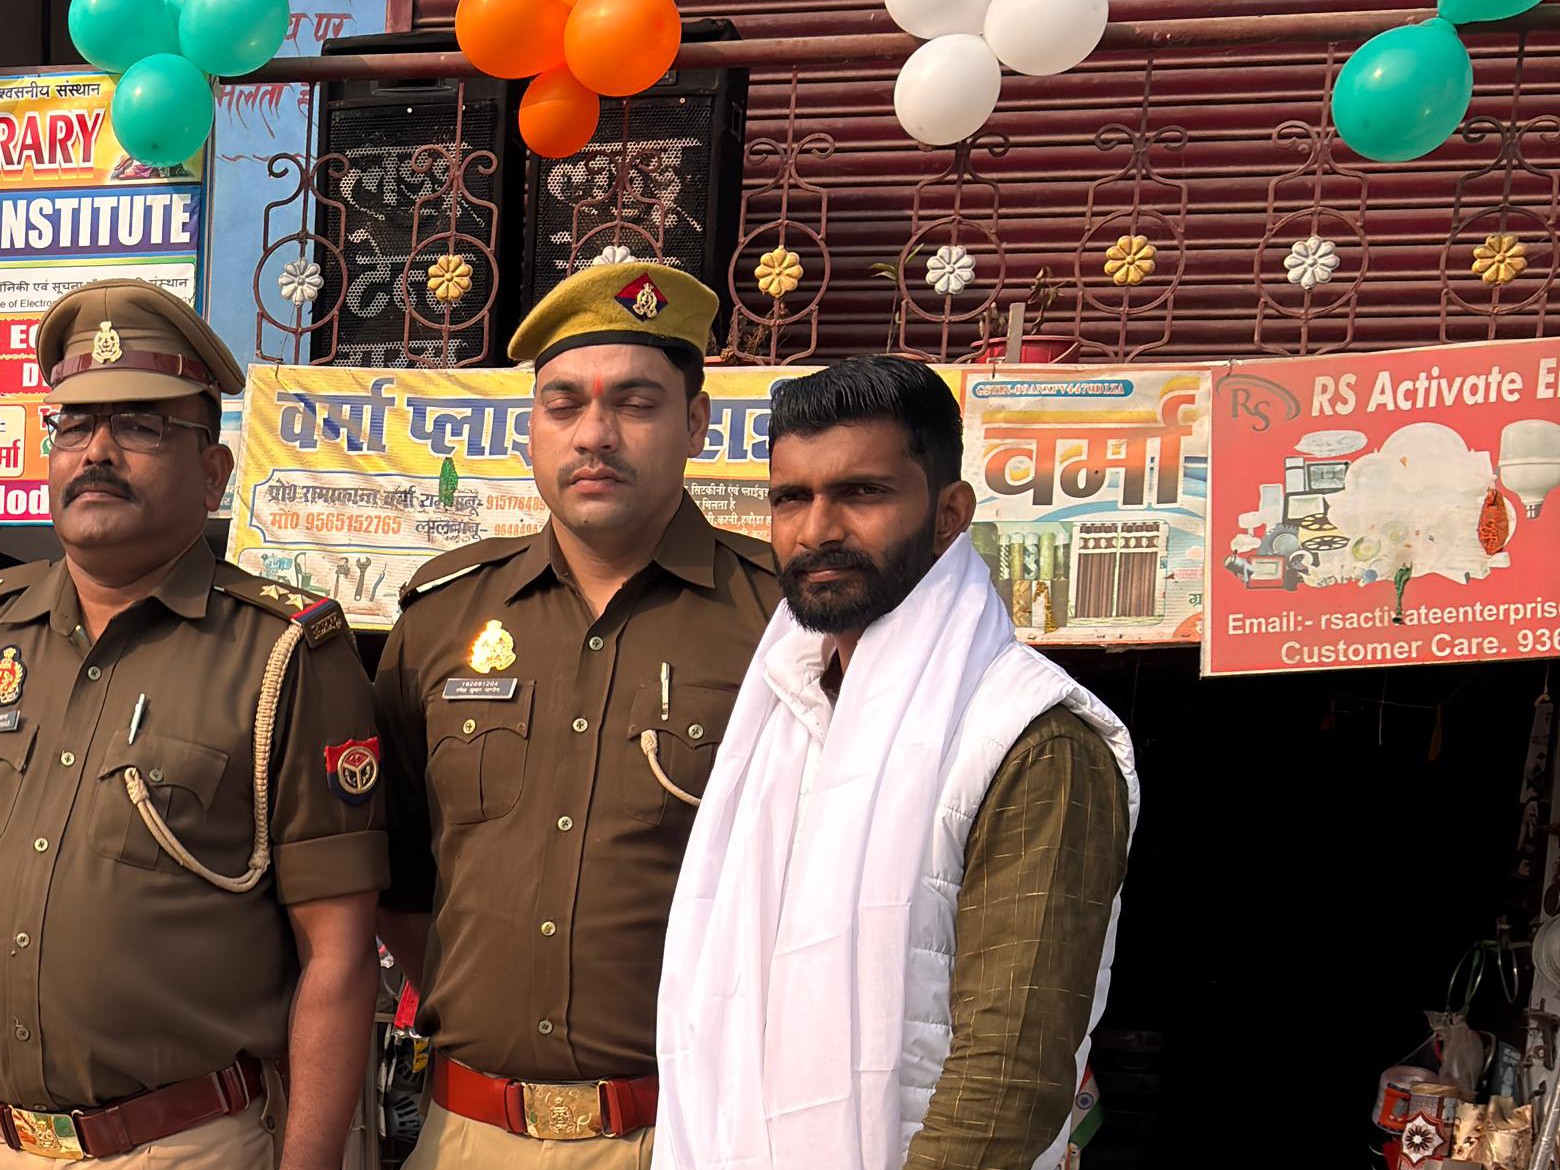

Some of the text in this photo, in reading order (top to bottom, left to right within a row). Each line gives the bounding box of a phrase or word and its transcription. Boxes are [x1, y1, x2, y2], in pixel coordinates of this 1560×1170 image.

[56, 79, 101, 98] संस्थान
[33, 279, 48, 291] एवं
[8, 299, 18, 308] of
[1311, 373, 1357, 417] RS
[1366, 365, 1524, 412] Activate
[277, 378, 396, 452] वर्मा
[983, 391, 1197, 508] वर्मा
[305, 514, 402, 534] 9565152765
[1228, 611, 1313, 635] Email:-
[1281, 638, 1422, 664] Customer
[1431, 633, 1507, 657] Care.
